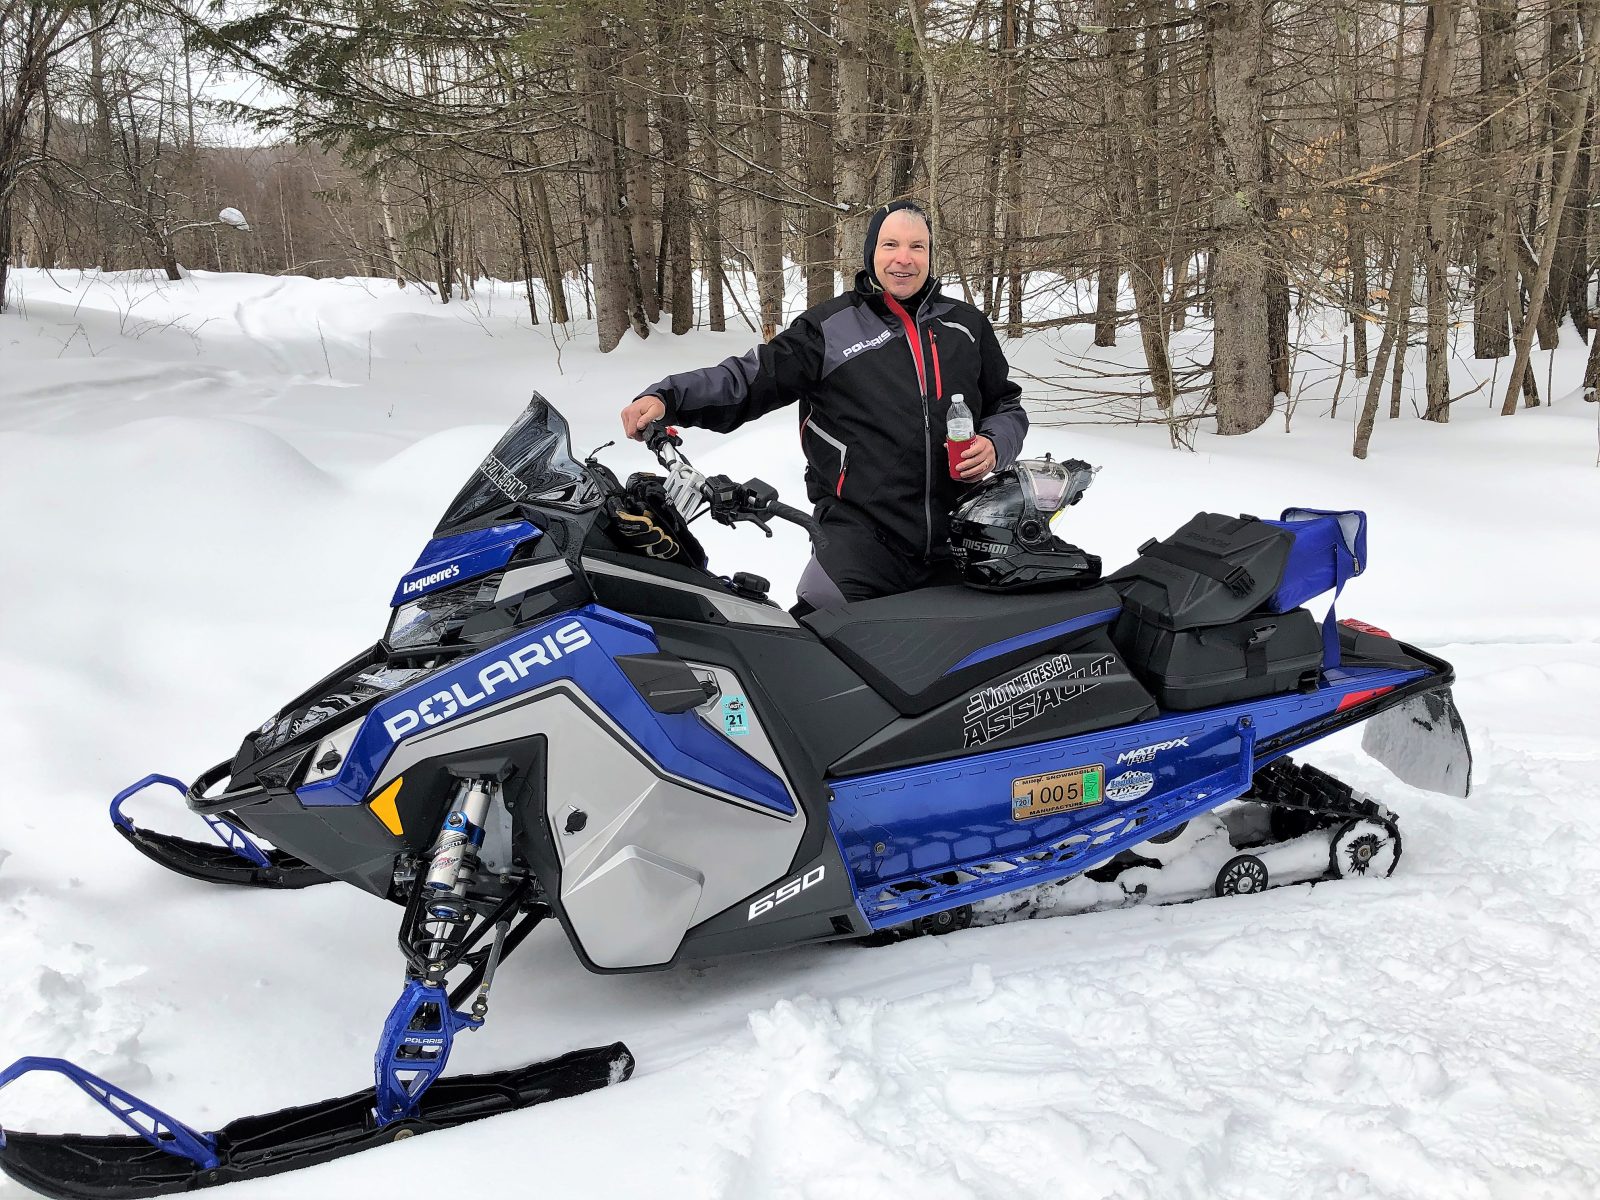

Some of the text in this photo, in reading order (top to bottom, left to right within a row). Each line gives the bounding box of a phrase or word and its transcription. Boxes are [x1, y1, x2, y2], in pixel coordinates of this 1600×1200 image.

[842, 329, 891, 358] POLARIS
[403, 564, 460, 595] Laquerre's
[383, 621, 592, 743] POLARIS
[963, 654, 1116, 749] ASSAULT
[1116, 736, 1190, 765] MATRYX
[1045, 767, 1096, 781] SNOWMOBILE
[1027, 782, 1078, 806] 1005
[748, 865, 826, 922] 650
[404, 1037, 444, 1045] POLARIS
